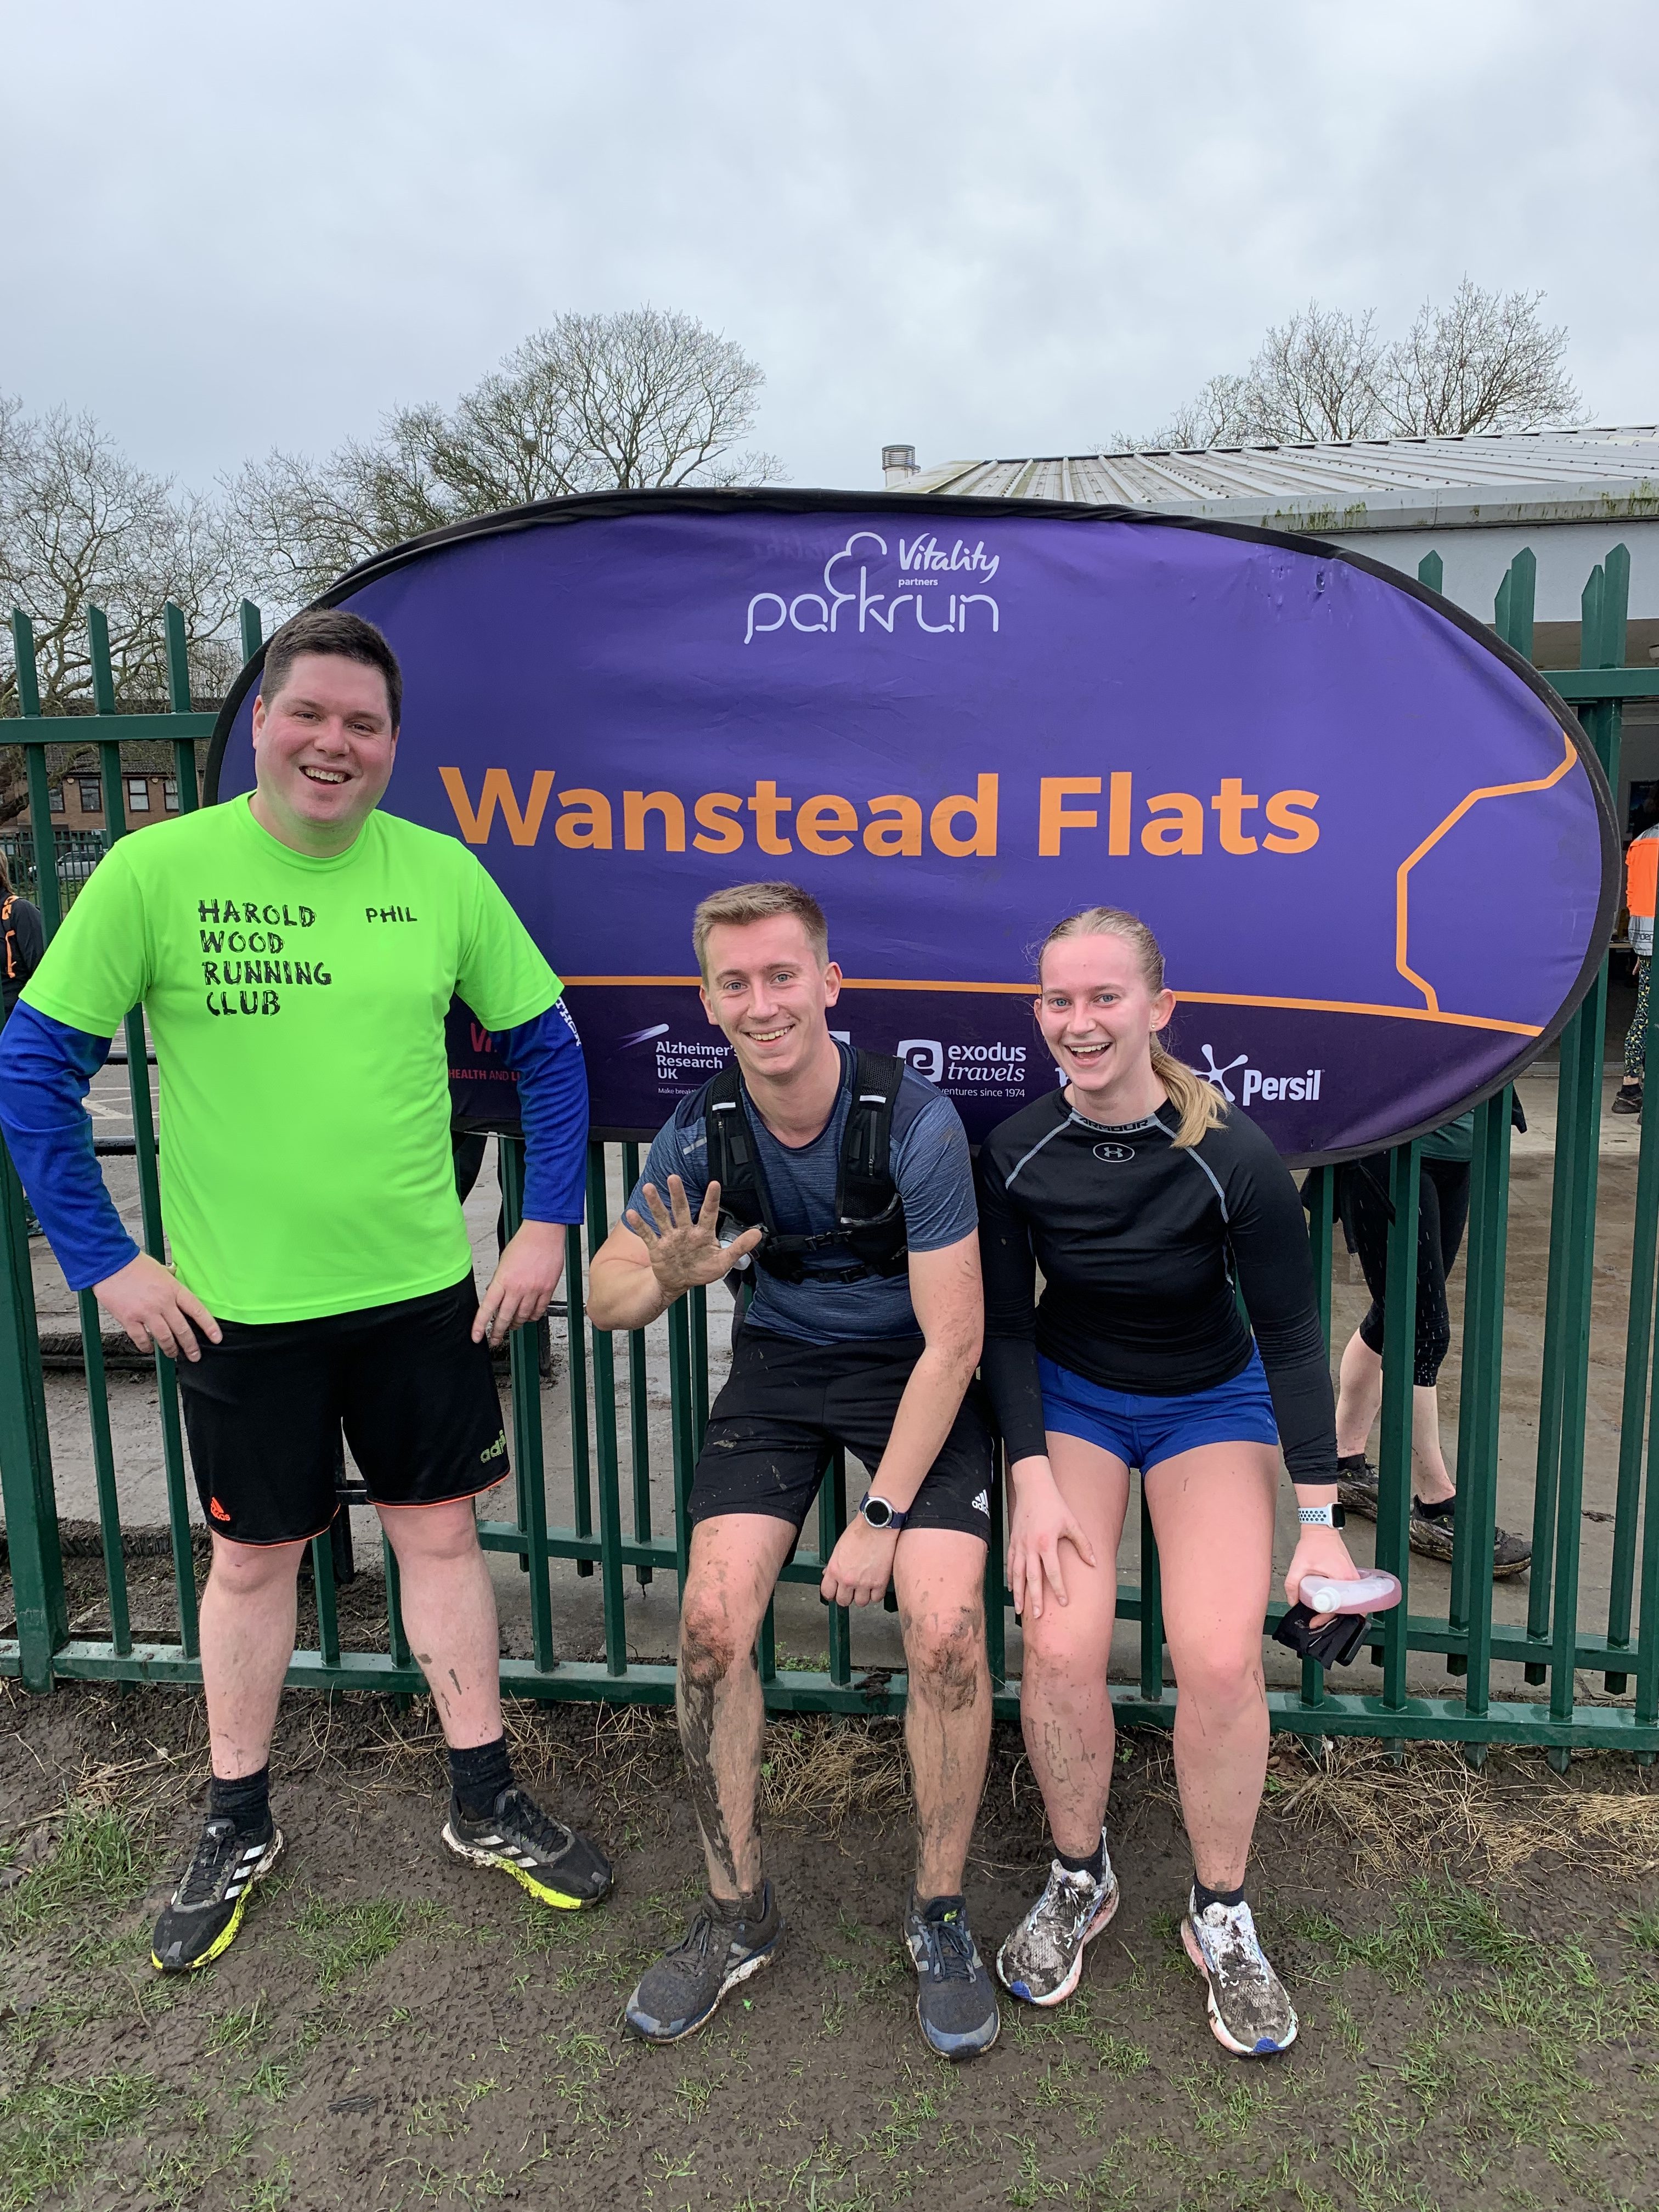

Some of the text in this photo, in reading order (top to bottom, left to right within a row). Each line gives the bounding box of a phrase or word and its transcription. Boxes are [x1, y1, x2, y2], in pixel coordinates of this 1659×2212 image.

[899, 533, 1000, 584] Vitality
[899, 577, 938, 588] partners
[744, 566, 999, 645] parkrun
[438, 766, 1320, 857] Wanstead Flats
[198, 899, 317, 927] HAROLD
[365, 905, 417, 923] PHIL
[200, 930, 285, 953] WOOD
[202, 960, 332, 985] RUNNING
[206, 990, 280, 1016] CLUB
[656, 1054, 723, 1069] Research
[947, 1042, 1026, 1062] exodus
[489, 1070, 509, 1080] AND
[657, 1068, 679, 1080] UK
[947, 1062, 1025, 1082] travels
[980, 1088, 1003, 1097] since
[1005, 1088, 1025, 1097] 1974
[1243, 1069, 1321, 1106] Persil
[1079, 1117, 1148, 1132] ARMOUR
